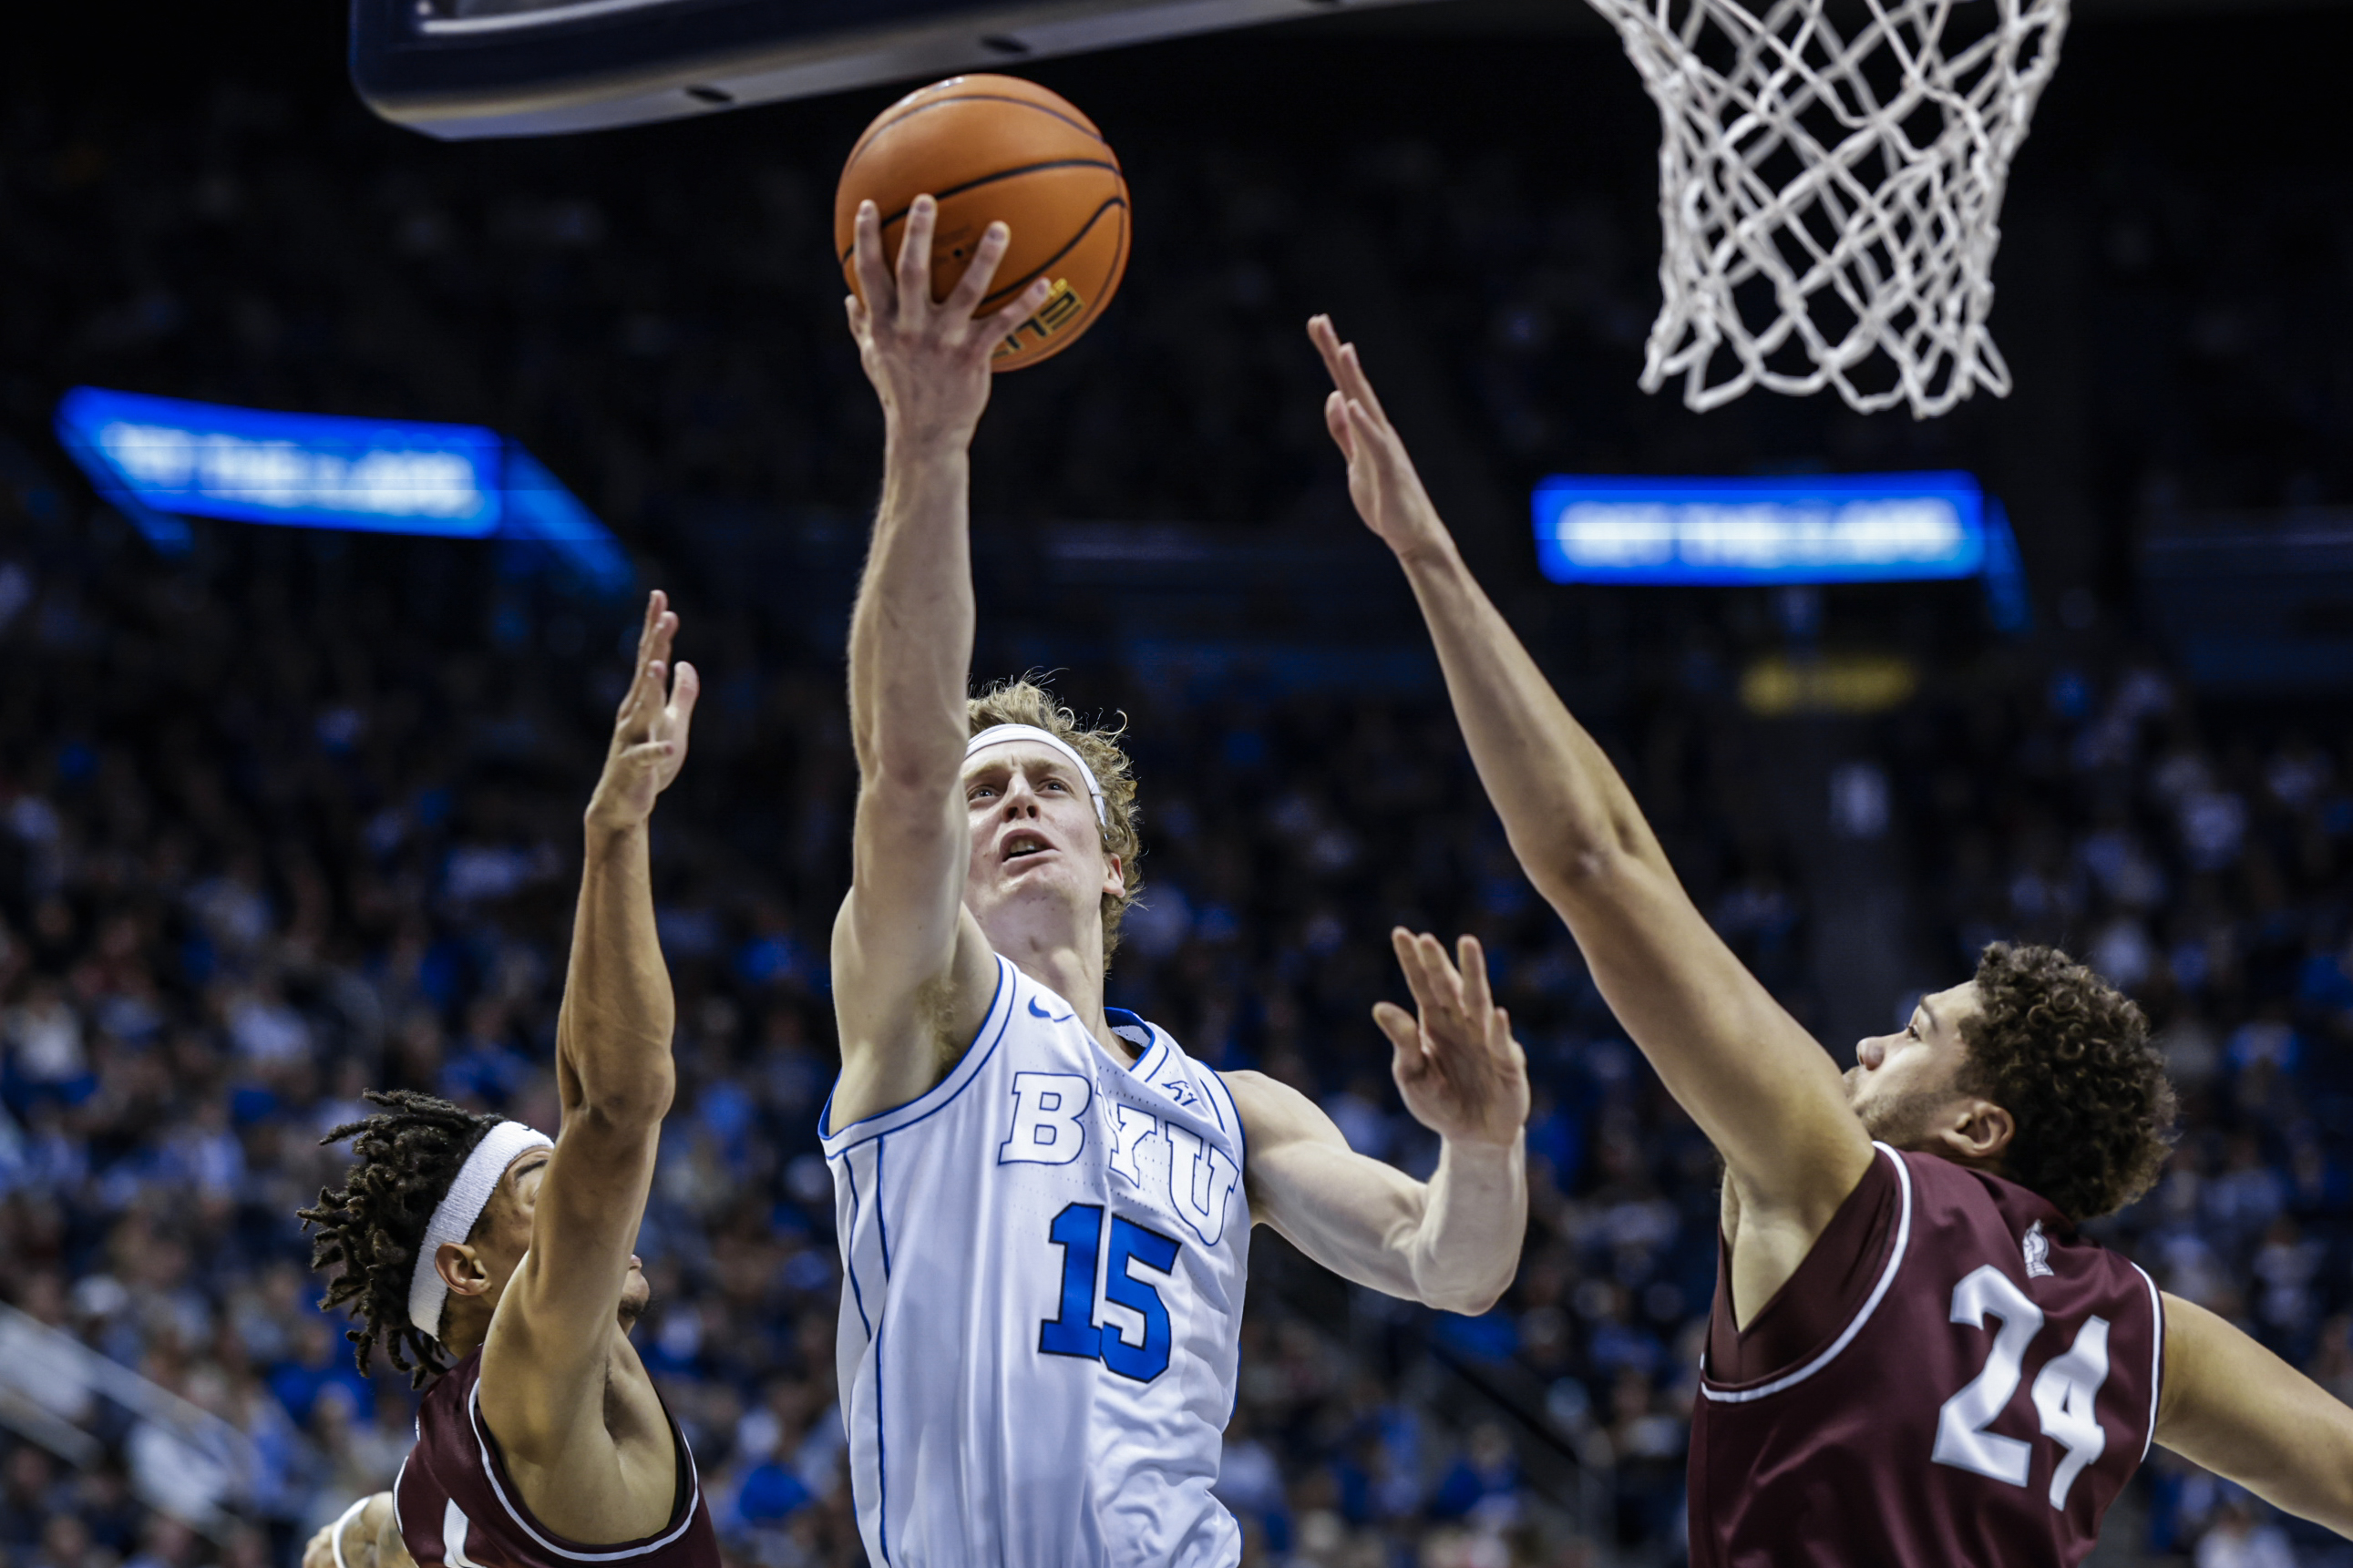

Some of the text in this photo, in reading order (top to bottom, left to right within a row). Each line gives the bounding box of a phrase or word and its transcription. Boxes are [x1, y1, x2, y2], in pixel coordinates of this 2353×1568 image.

[992, 289, 1085, 358] ELI
[998, 1072, 1239, 1245] BYU
[1038, 1202, 1182, 1384] 15
[1930, 1264, 2111, 1512] 24
